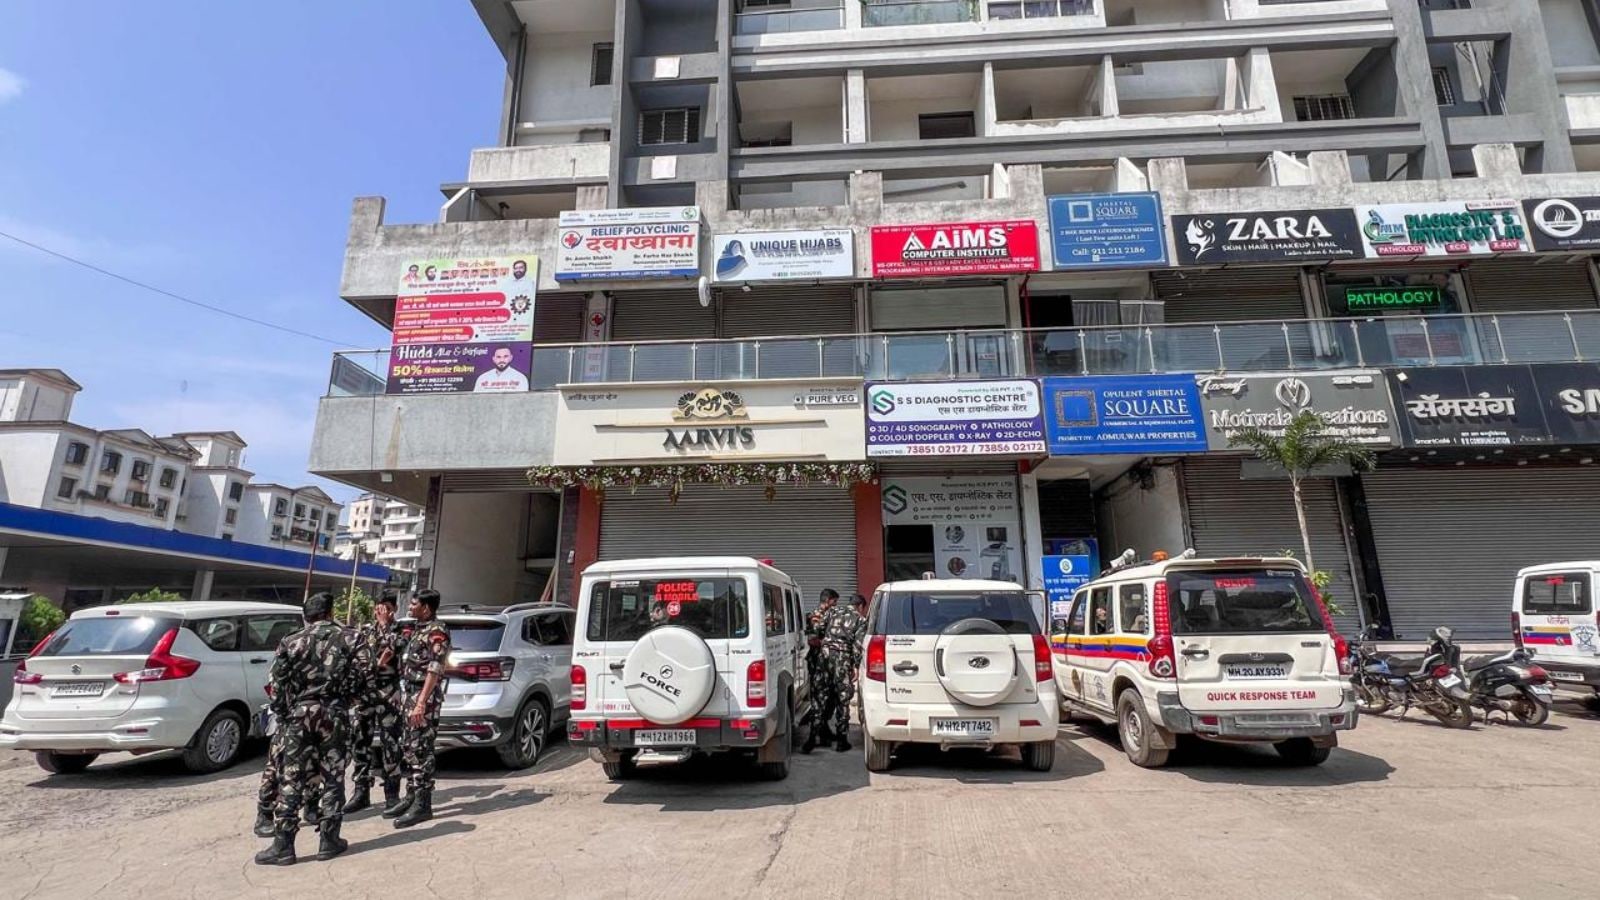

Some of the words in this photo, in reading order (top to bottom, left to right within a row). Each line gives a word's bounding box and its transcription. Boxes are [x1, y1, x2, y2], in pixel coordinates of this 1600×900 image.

[1096, 206, 1138, 217] SQUARE
[1405, 212, 1496, 230] DIAGNOSTIC
[1502, 210, 1514, 224] &
[591, 226, 624, 236] RELIEF
[626, 224, 690, 234] POLYCLINIC
[1226, 216, 1332, 240] ZARA
[1408, 226, 1492, 244] PATHOLOGY
[1494, 224, 1525, 241] LAB
[586, 234, 696, 253] दवाखाना
[750, 240, 796, 250] UNIQUE
[800, 238, 841, 248] HIJABS
[930, 229, 1008, 250] AiMS
[1222, 244, 1242, 252] SKIN
[1378, 244, 1424, 254] PATHOLOGY
[1450, 243, 1468, 251] ECG
[1493, 240, 1518, 250] X-RAY
[902, 250, 955, 259] COMPUTER
[956, 248, 1008, 257] INSTITUTE
[1348, 290, 1434, 305] PATHOLOGY
[393, 365, 422, 376] 50%
[808, 396, 832, 404] PURE
[834, 394, 855, 402] VEG
[898, 396, 904, 405] S
[906, 396, 912, 405] S
[915, 394, 982, 404] DIAGNOSTIC
[983, 393, 1026, 402] CENTRE
[1104, 390, 1143, 398] OPULENT
[1147, 388, 1186, 396] SHEETAL
[952, 406, 966, 414] एस
[1104, 398, 1188, 417] SQUARE
[1210, 408, 1293, 428] Motiwala
[896, 424, 907, 432] 4D
[908, 424, 967, 432] SONOGRAPHY
[982, 422, 1034, 430] PATHOLOGY
[663, 427, 754, 448] AARVI'S
[878, 434, 914, 442] COLOUR
[916, 433, 956, 441] DOPPLER
[966, 432, 992, 440] X-RAY
[1003, 430, 1042, 438] 2D-ECHO
[1096, 432, 1146, 441] ADMULWAR
[1148, 431, 1197, 440] PROPERTIES
[906, 445, 936, 454] 73851
[938, 444, 968, 454] 02172
[980, 444, 1010, 452] 73856
[1012, 442, 1044, 451] 02172
[656, 582, 695, 592] POLICE
[640, 671, 682, 698] FORCE
[1207, 692, 1238, 702] QUICK
[1240, 691, 1288, 701] RESPONSE
[1290, 690, 1316, 700] TEAM
